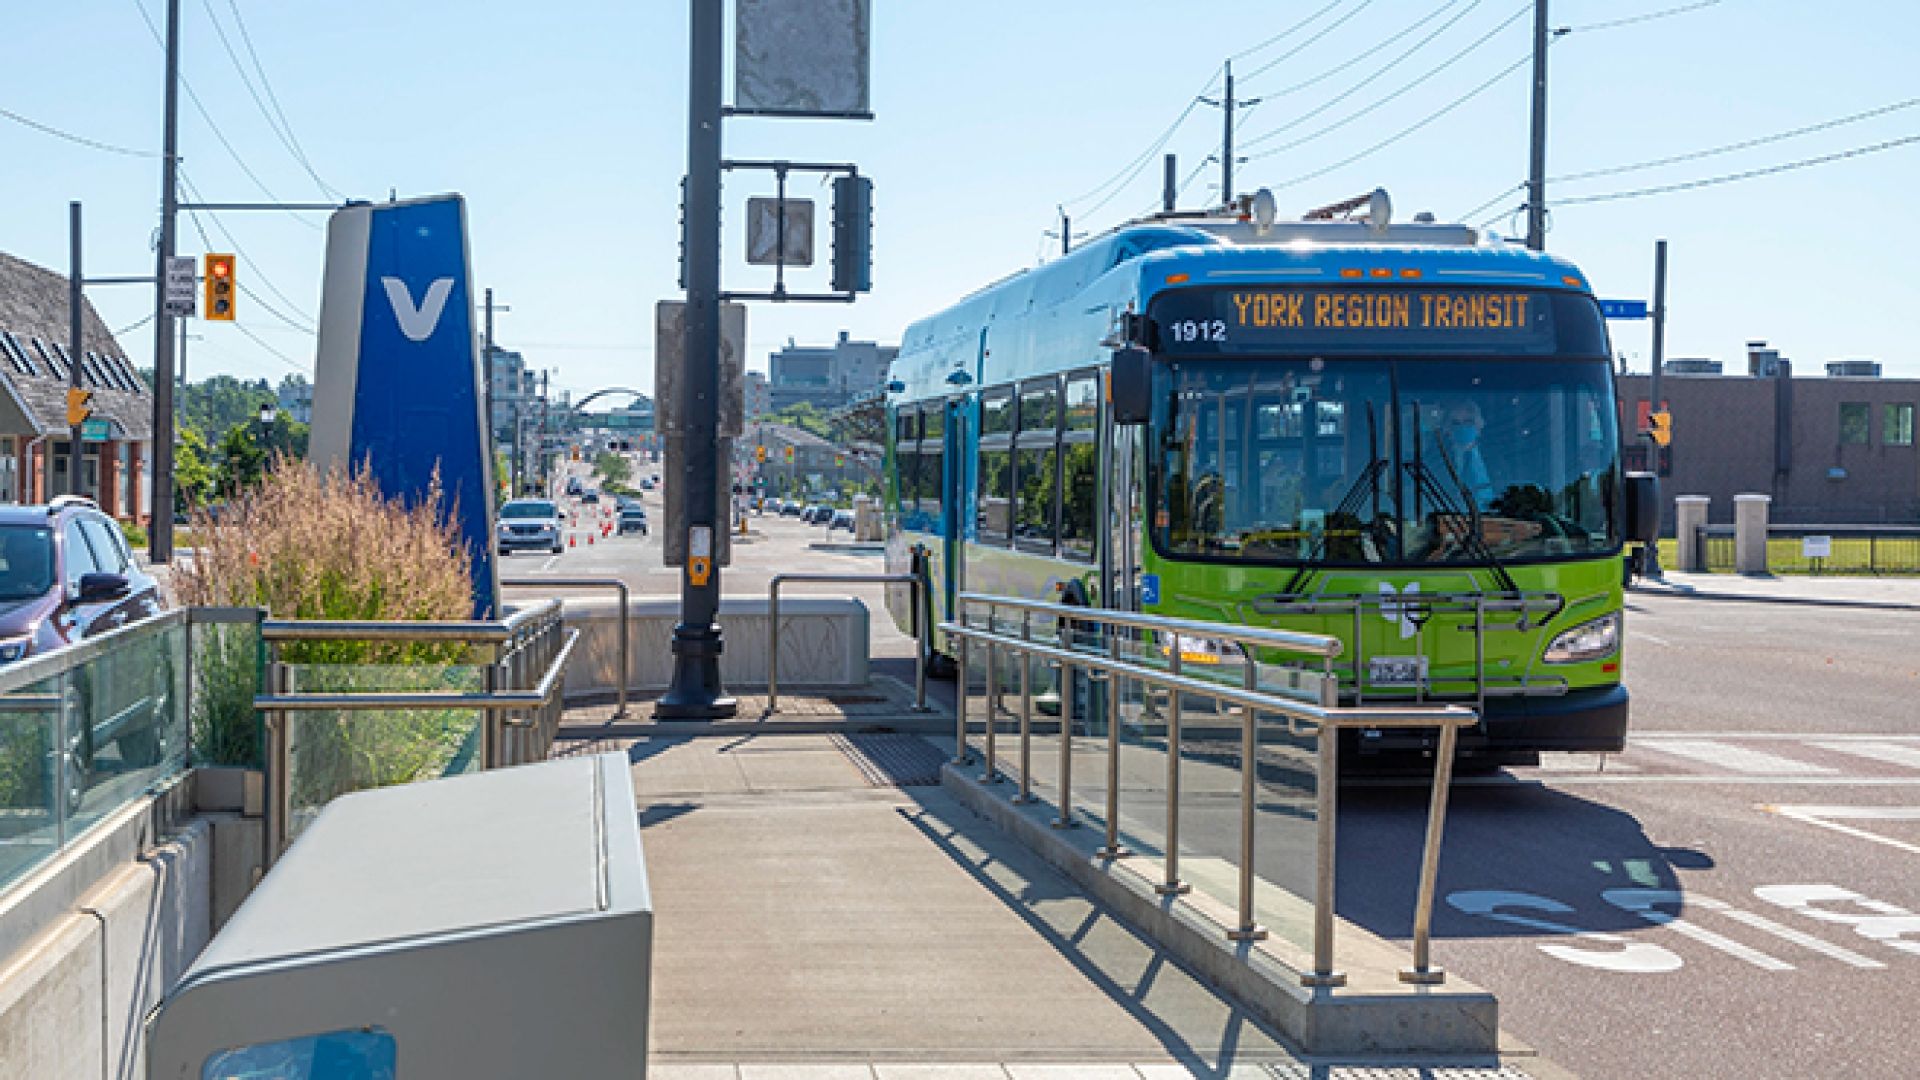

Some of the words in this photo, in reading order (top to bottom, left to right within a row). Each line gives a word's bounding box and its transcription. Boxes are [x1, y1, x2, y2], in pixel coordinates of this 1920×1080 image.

[1233, 293, 1304, 327] YORK
[1314, 293, 1409, 327] REGION
[1419, 293, 1529, 327] TRANSIT
[1171, 319, 1227, 342] 1912
